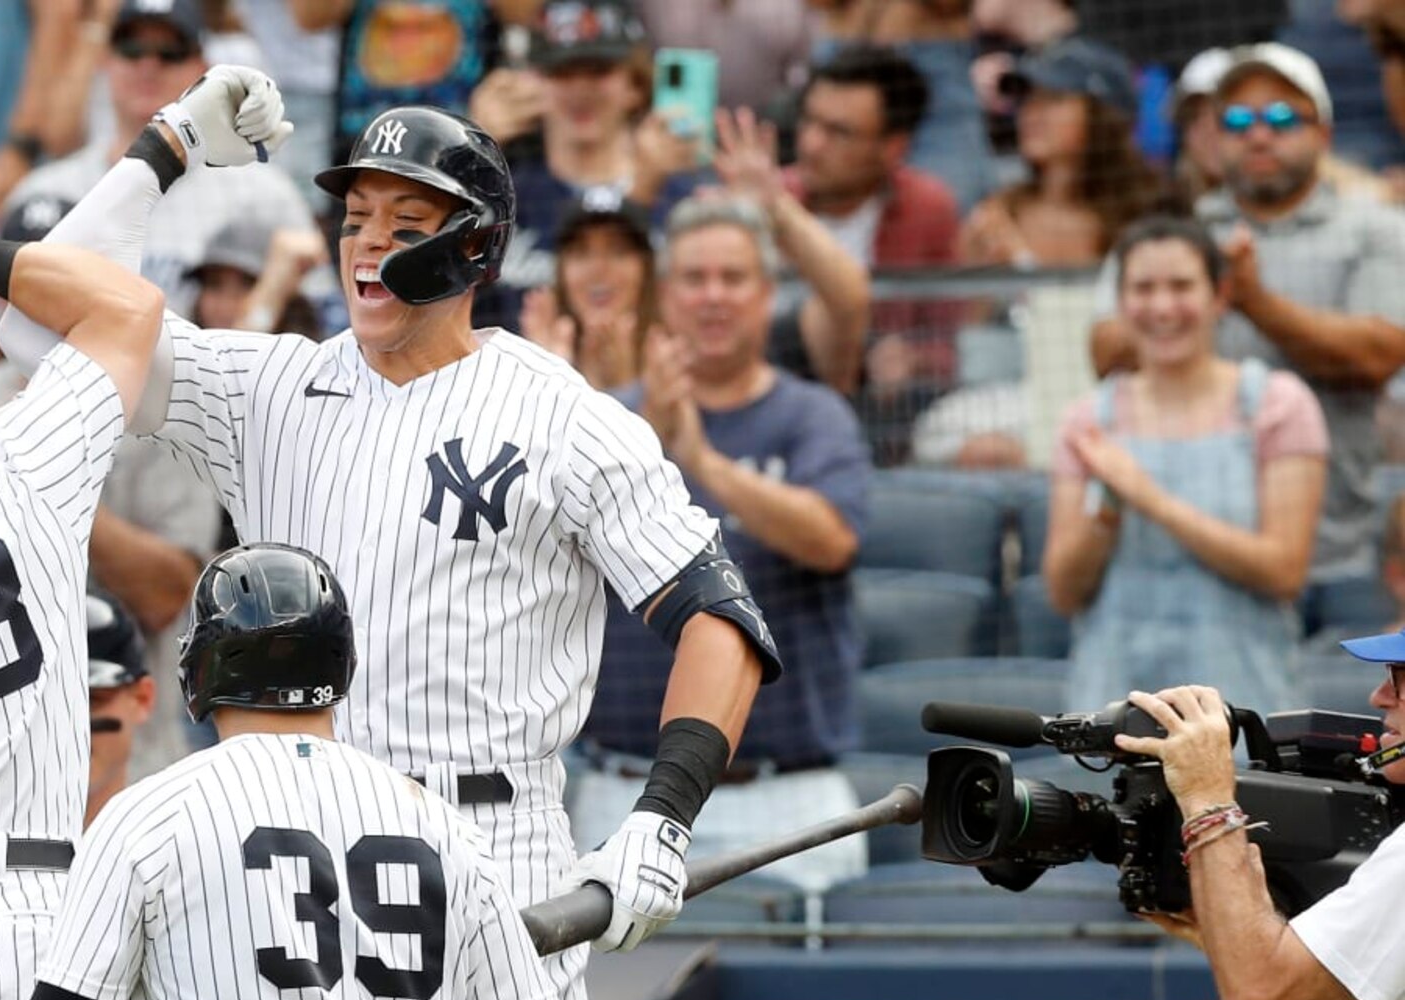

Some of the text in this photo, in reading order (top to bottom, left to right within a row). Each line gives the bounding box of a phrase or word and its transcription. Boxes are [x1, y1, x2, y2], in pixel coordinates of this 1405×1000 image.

[371, 119, 408, 155] NY
[420, 437, 529, 542] NY
[312, 685, 333, 704] 39
[242, 826, 447, 1000] 39
